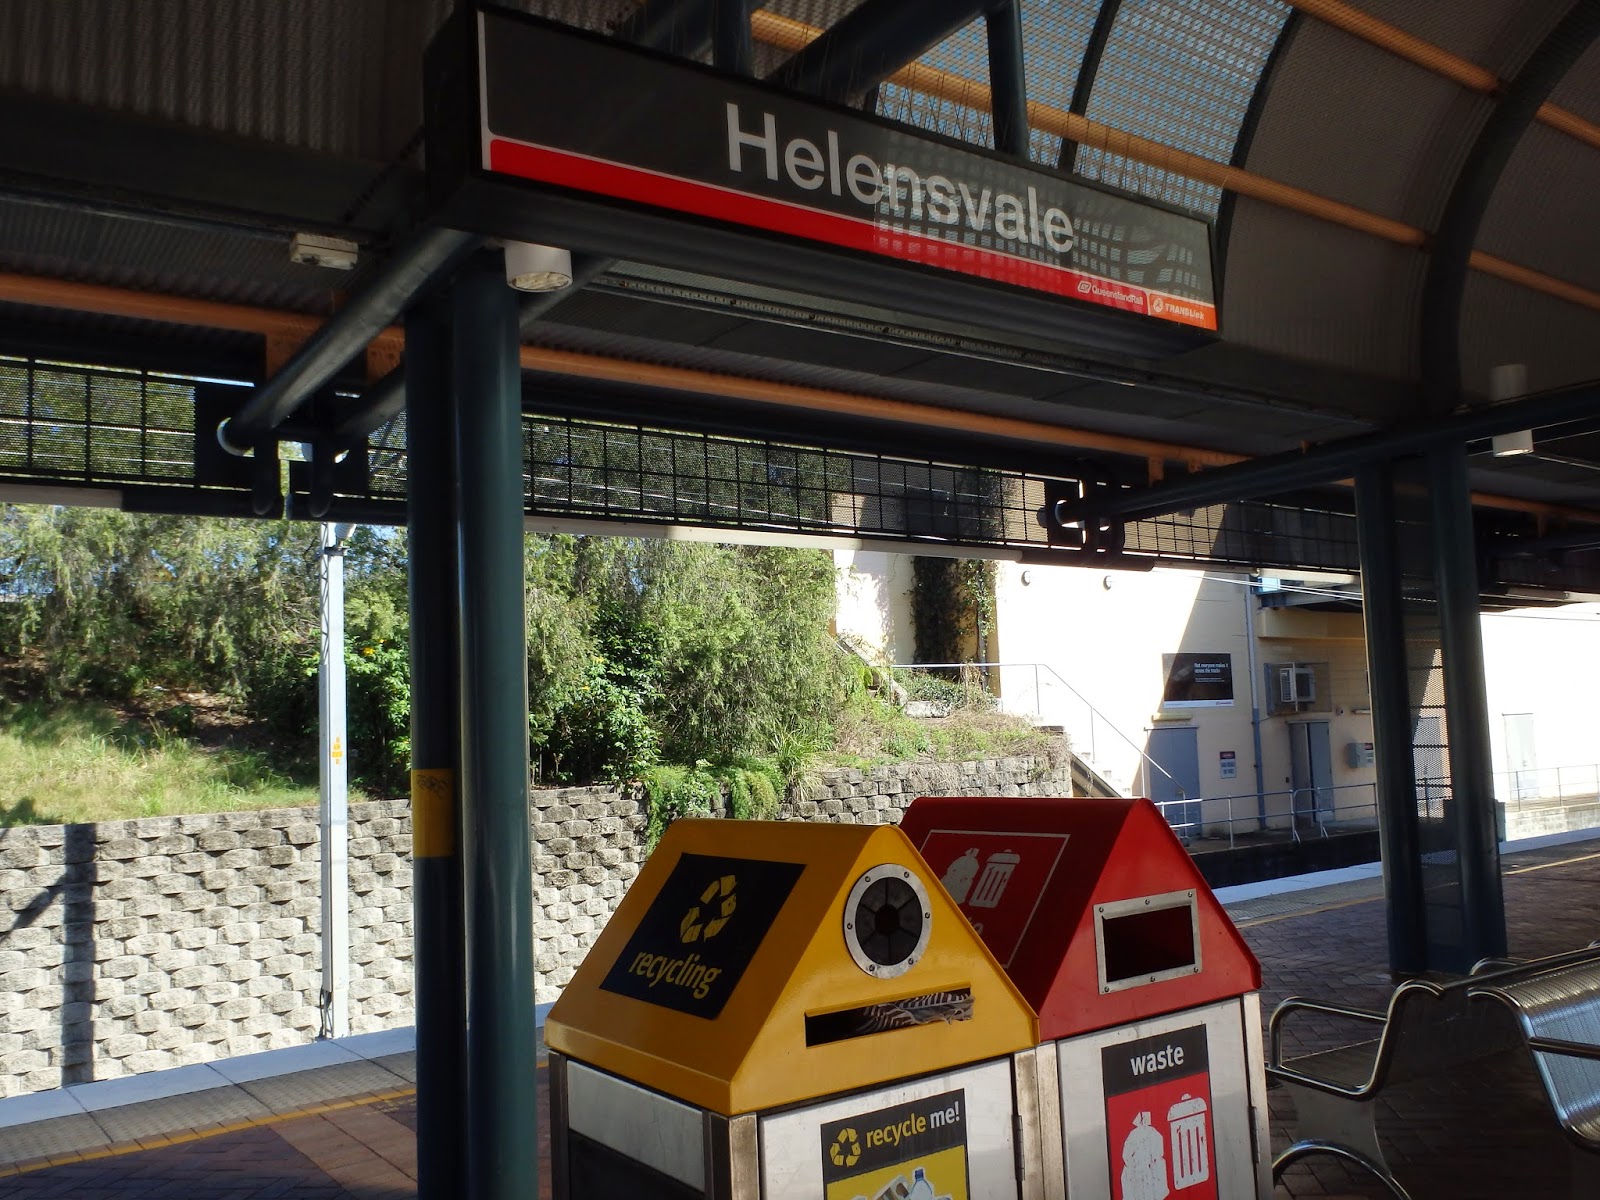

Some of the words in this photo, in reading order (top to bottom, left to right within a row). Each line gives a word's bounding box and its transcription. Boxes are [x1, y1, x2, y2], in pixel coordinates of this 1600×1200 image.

[726, 103, 1074, 253] Helensvale
[628, 949, 722, 999] recycling
[1130, 1044, 1184, 1076] waste
[866, 1112, 926, 1148] recycle
[929, 1101, 960, 1130] me!
